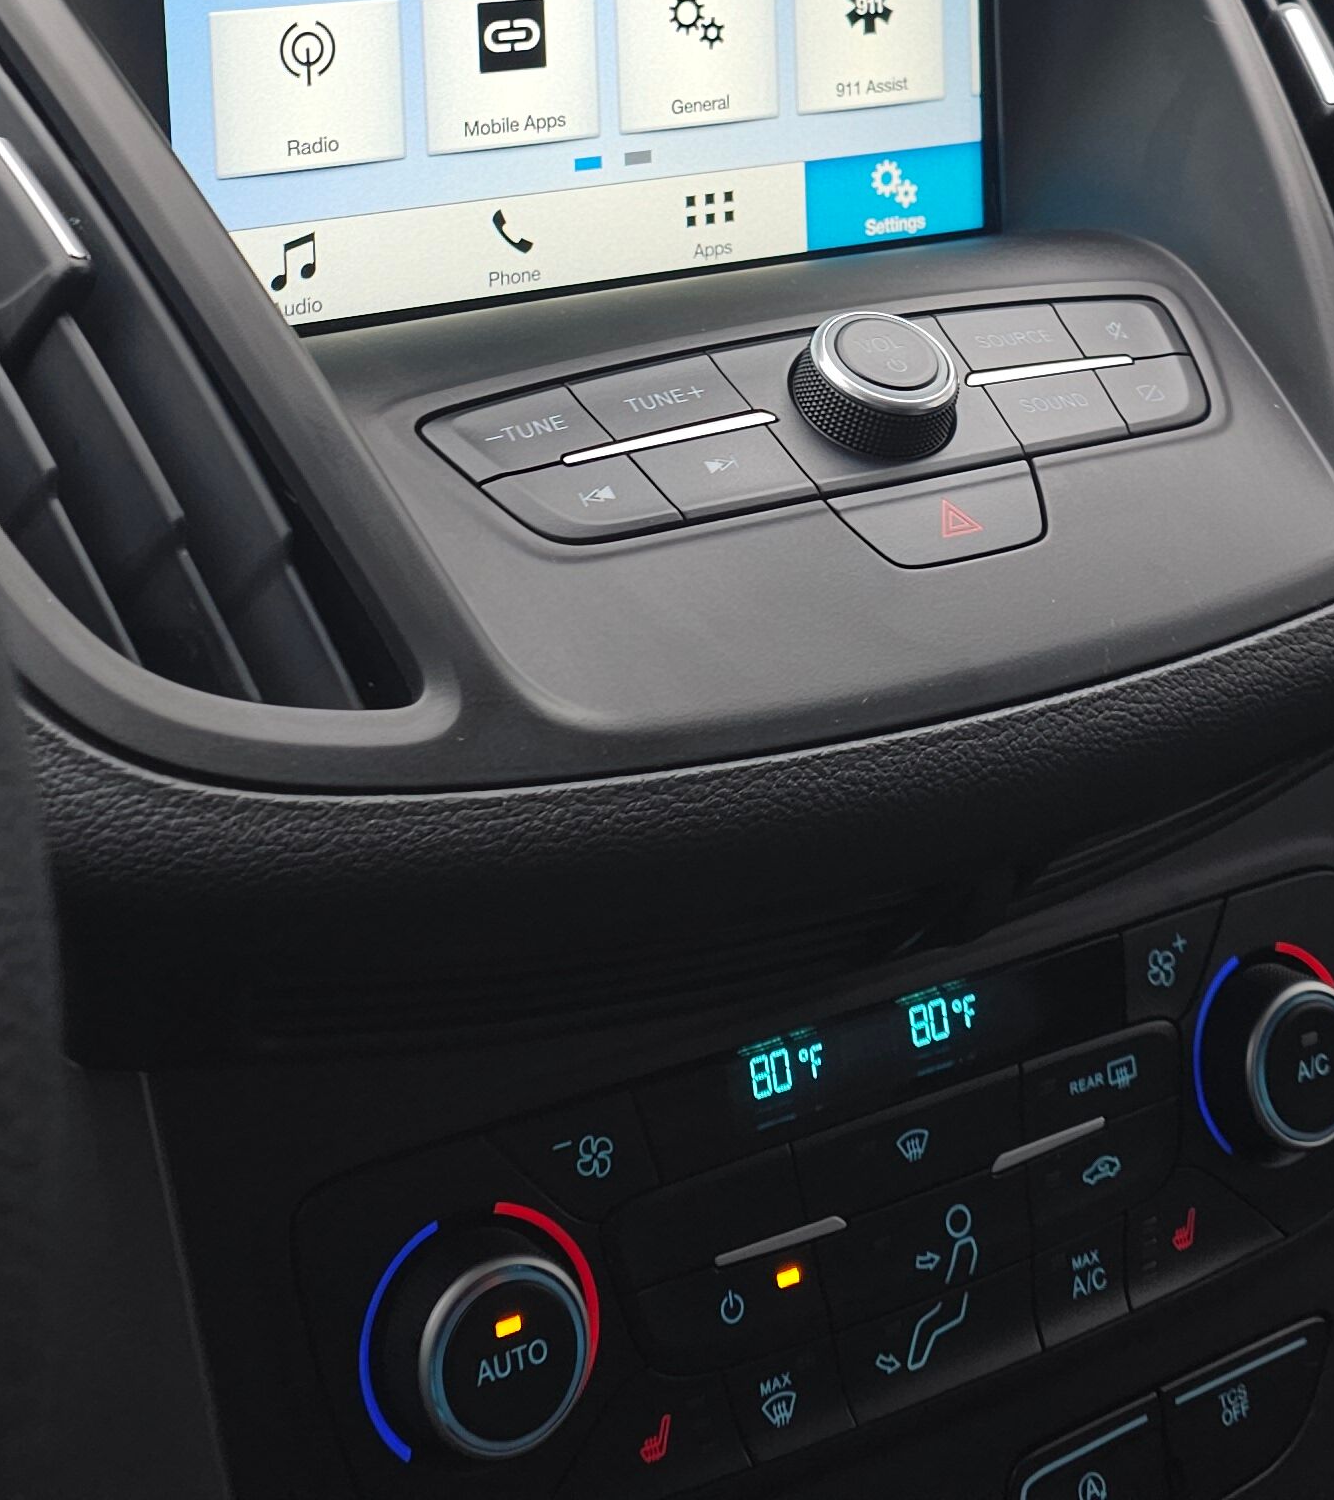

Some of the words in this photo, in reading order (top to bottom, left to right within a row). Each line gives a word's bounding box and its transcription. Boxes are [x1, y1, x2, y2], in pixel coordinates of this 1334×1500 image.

[835, 79, 860, 97] 911
[864, 76, 909, 95] Assist
[671, 94, 731, 116] General
[463, 115, 520, 137] Mobile
[523, 112, 567, 136] Apps
[287, 135, 340, 157] Radio
[865, 212, 927, 239] Settings
[693, 239, 734, 262] Apps
[488, 266, 542, 288] Phone
[274, 297, 323, 317] udio
[854, 333, 904, 354] VOL
[975, 329, 1053, 349] SOURCE
[1019, 393, 1089, 414] SOUND
[1296, 1051, 1331, 1081] A/C
[1069, 1070, 1105, 1094] REAR
[1071, 1249, 1100, 1271] MAX
[1072, 1266, 1108, 1299] A/C
[475, 1338, 549, 1387] AUTO
[759, 1371, 793, 1398] MAX
[1218, 1383, 1248, 1407] TCS
[1221, 1401, 1250, 1427] OFF
